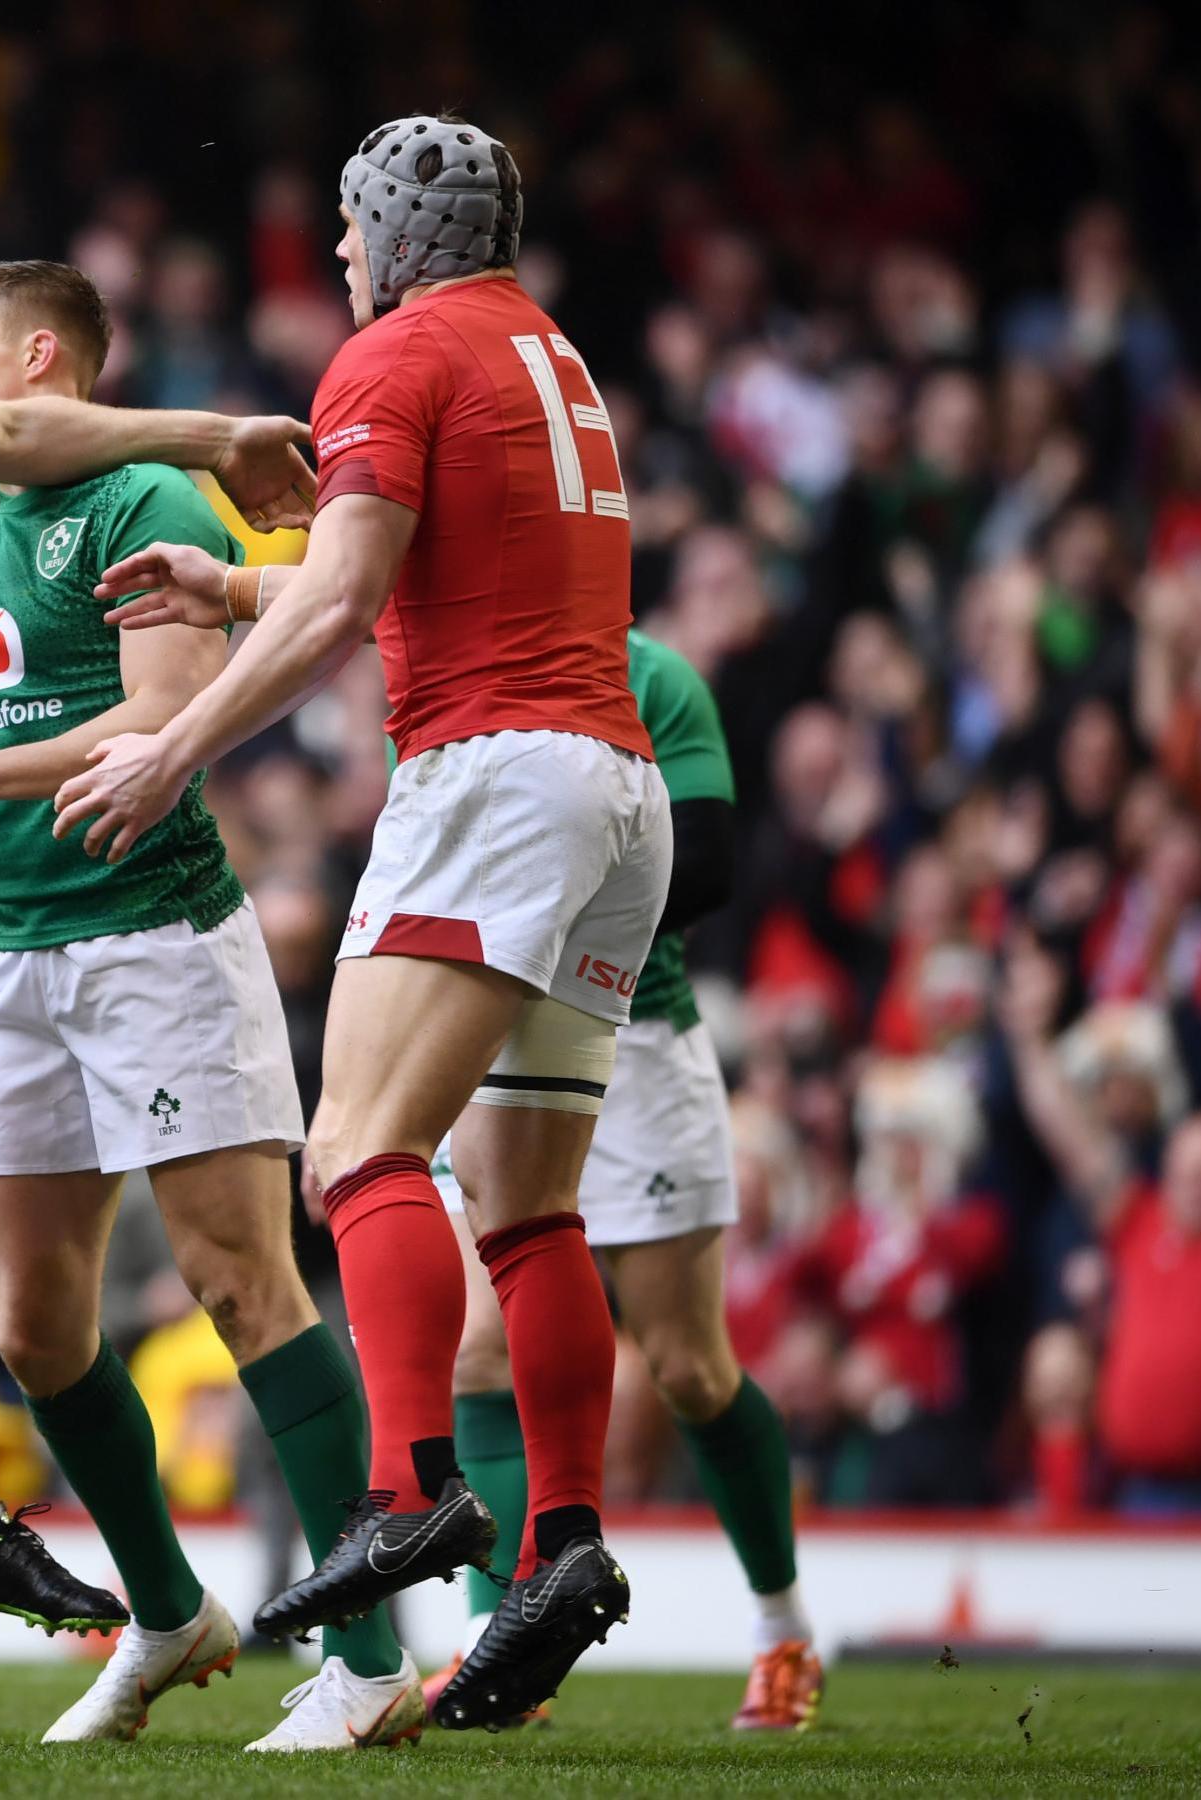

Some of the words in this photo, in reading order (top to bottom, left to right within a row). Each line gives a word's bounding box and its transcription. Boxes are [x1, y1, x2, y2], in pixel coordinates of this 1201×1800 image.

[509, 332, 630, 521] 13
[575, 953, 638, 998] ISU
[158, 1123, 182, 1137] IRFU
